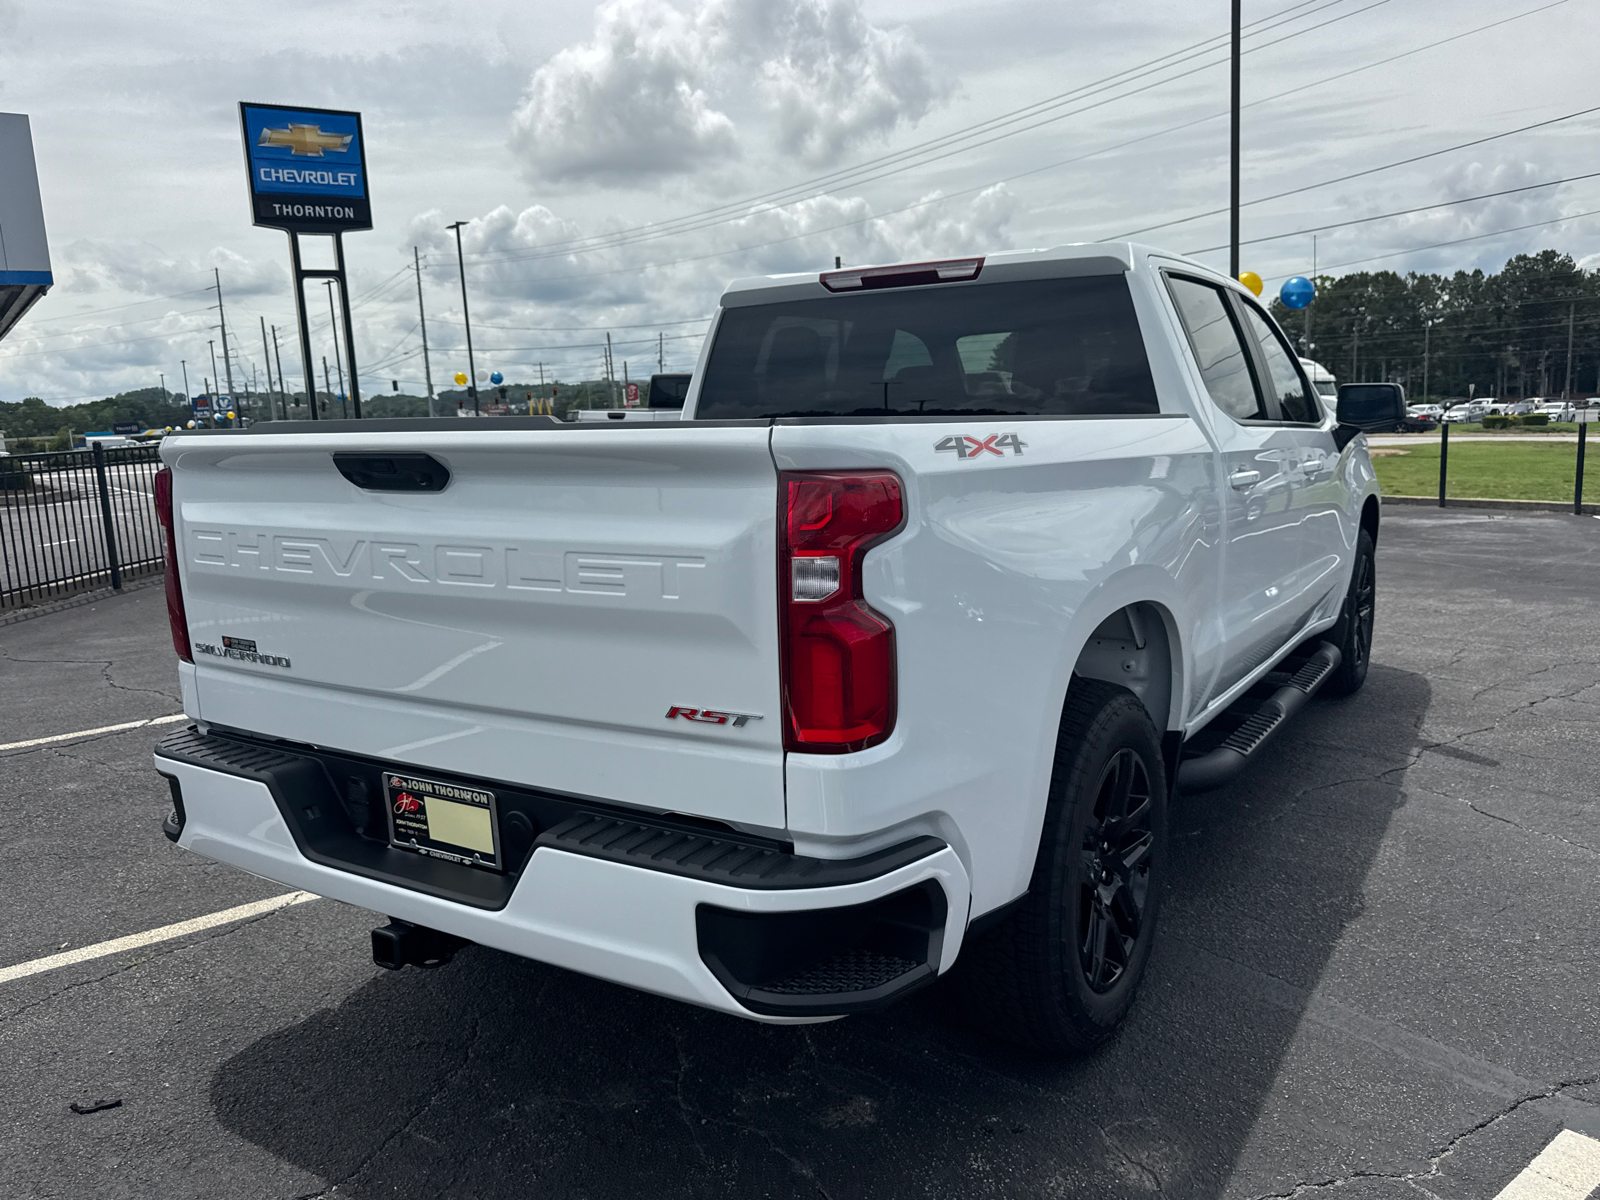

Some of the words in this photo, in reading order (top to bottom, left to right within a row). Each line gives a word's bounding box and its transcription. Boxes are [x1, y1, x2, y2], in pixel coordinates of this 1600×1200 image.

[260, 168, 357, 186] CHEVROLET
[273, 204, 355, 219] THORNTON
[191, 529, 706, 599] CHEVROLET
[195, 642, 291, 668] SILVERADO
[665, 704, 764, 728] RST
[408, 780, 433, 793] JOHN
[434, 785, 488, 804] THORNTON
[429, 850, 461, 863] CHEVROLET
